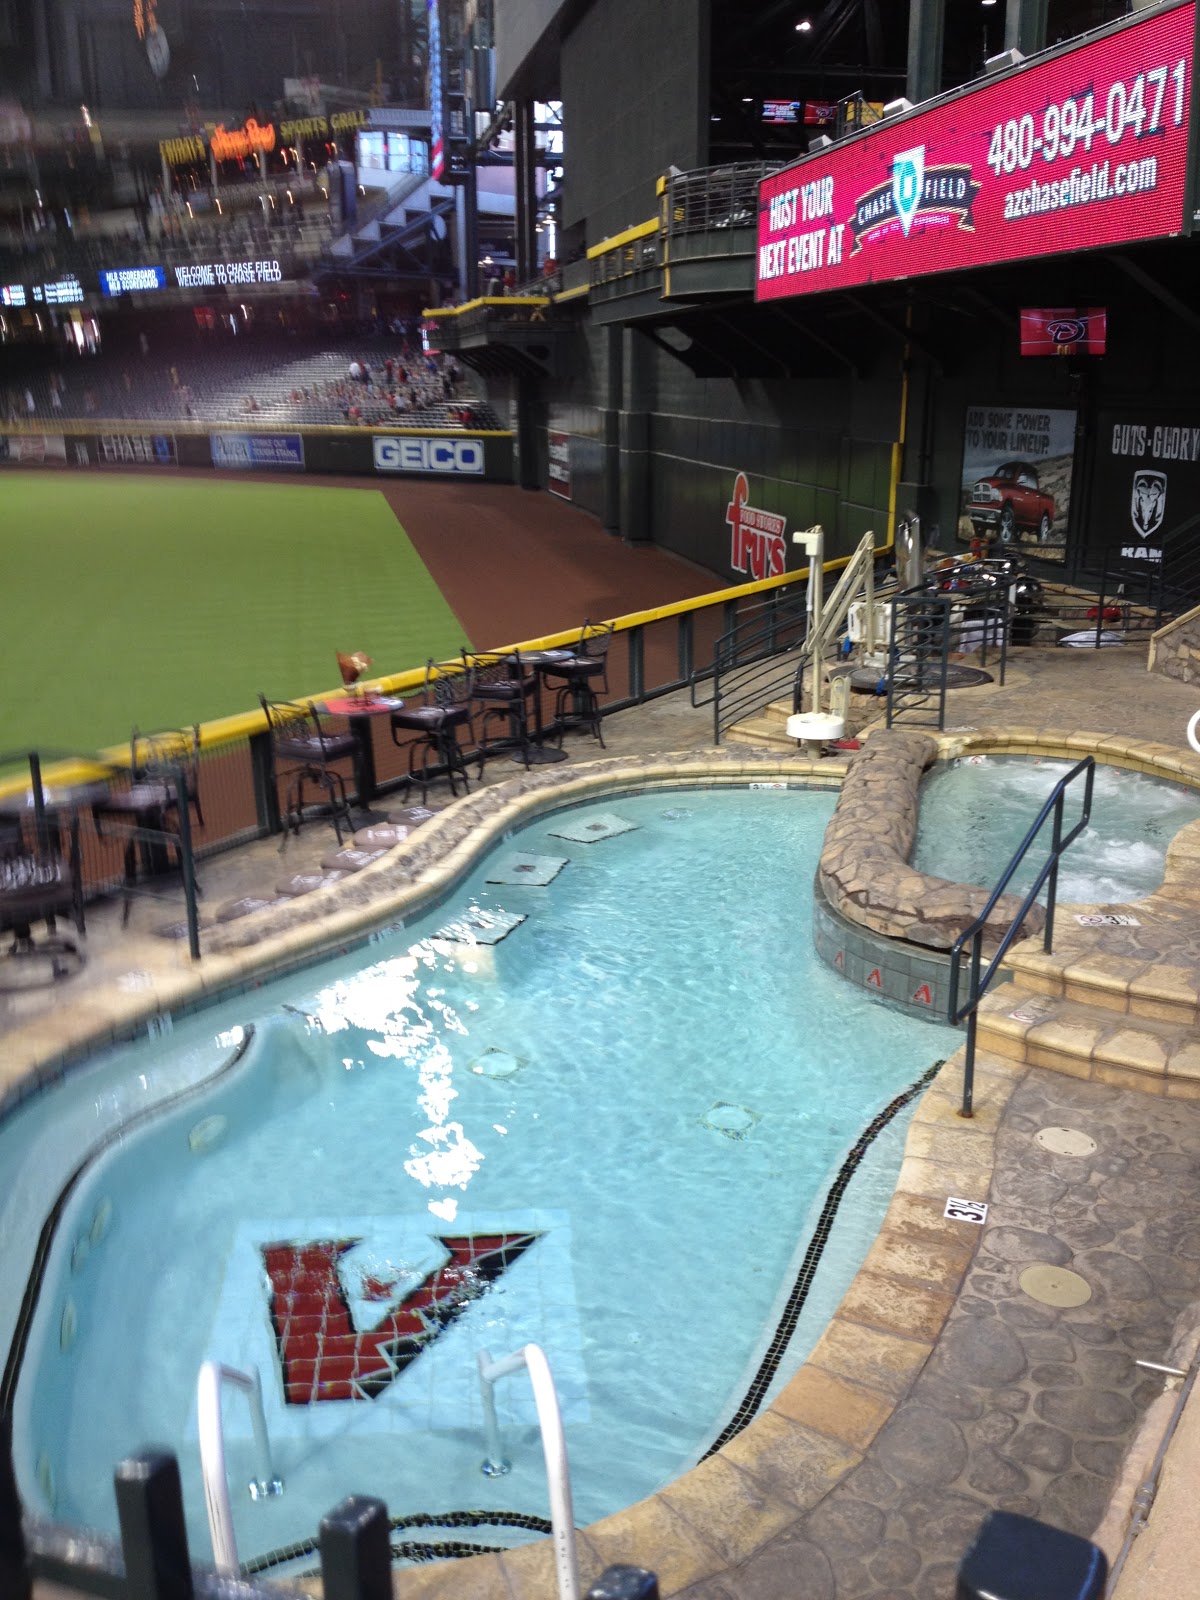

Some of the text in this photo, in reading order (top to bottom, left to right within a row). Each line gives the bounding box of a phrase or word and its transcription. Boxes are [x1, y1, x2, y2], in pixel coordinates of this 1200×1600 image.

[987, 58, 1186, 176] 480-994-0471
[769, 188, 800, 232] HOST
[801, 175, 834, 222] YOUR
[858, 191, 892, 226] CHASE
[925, 177, 966, 200] FIELD
[1004, 155, 1157, 221] azchasefield.com
[759, 223, 845, 281] NEXT EVENT AT
[967, 430, 980, 448] TO
[981, 430, 1008, 450] YOUR
[988, 411, 1012, 429] SOME
[1016, 413, 1051, 432] POWER
[375, 438, 483, 471] GEICO
